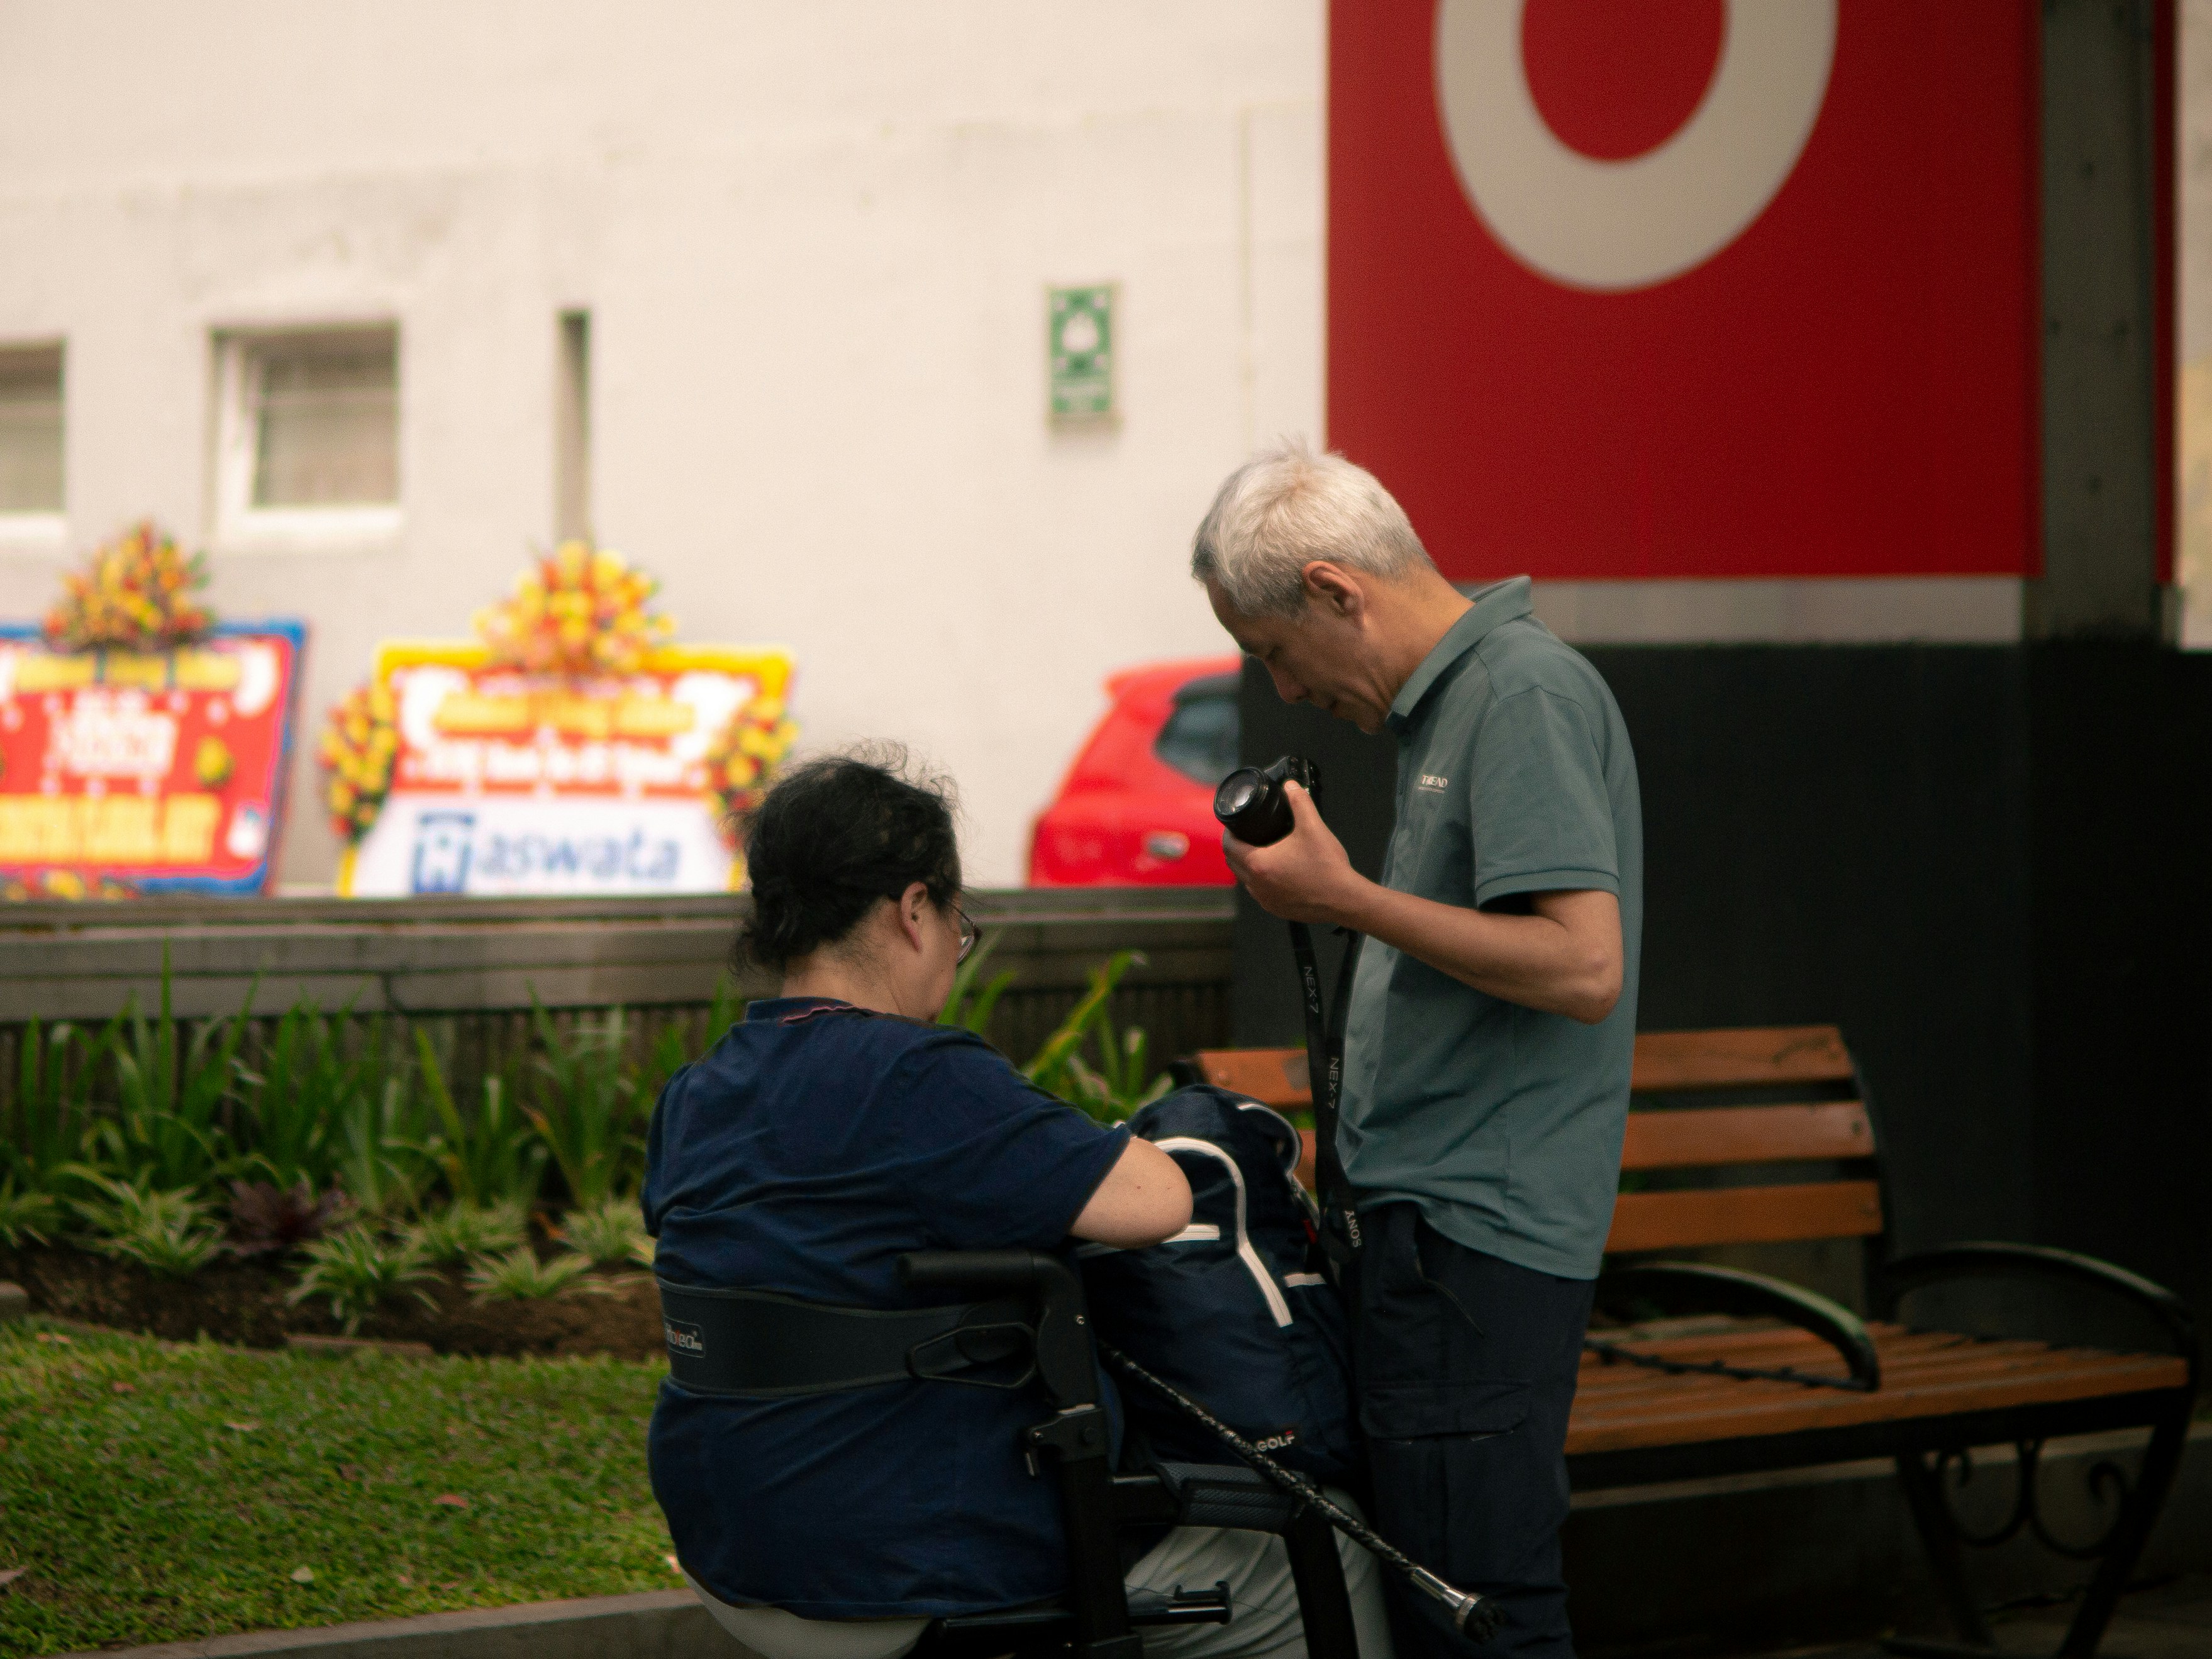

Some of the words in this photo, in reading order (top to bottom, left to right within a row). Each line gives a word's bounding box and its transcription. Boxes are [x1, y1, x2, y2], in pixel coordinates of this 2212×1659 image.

[1303, 966, 1319, 1014] NEX-7
[1328, 1056, 1340, 1109] NEX-7
[1344, 1210, 1361, 1248] SONY
[1257, 1434, 1295, 1452] GOLF
